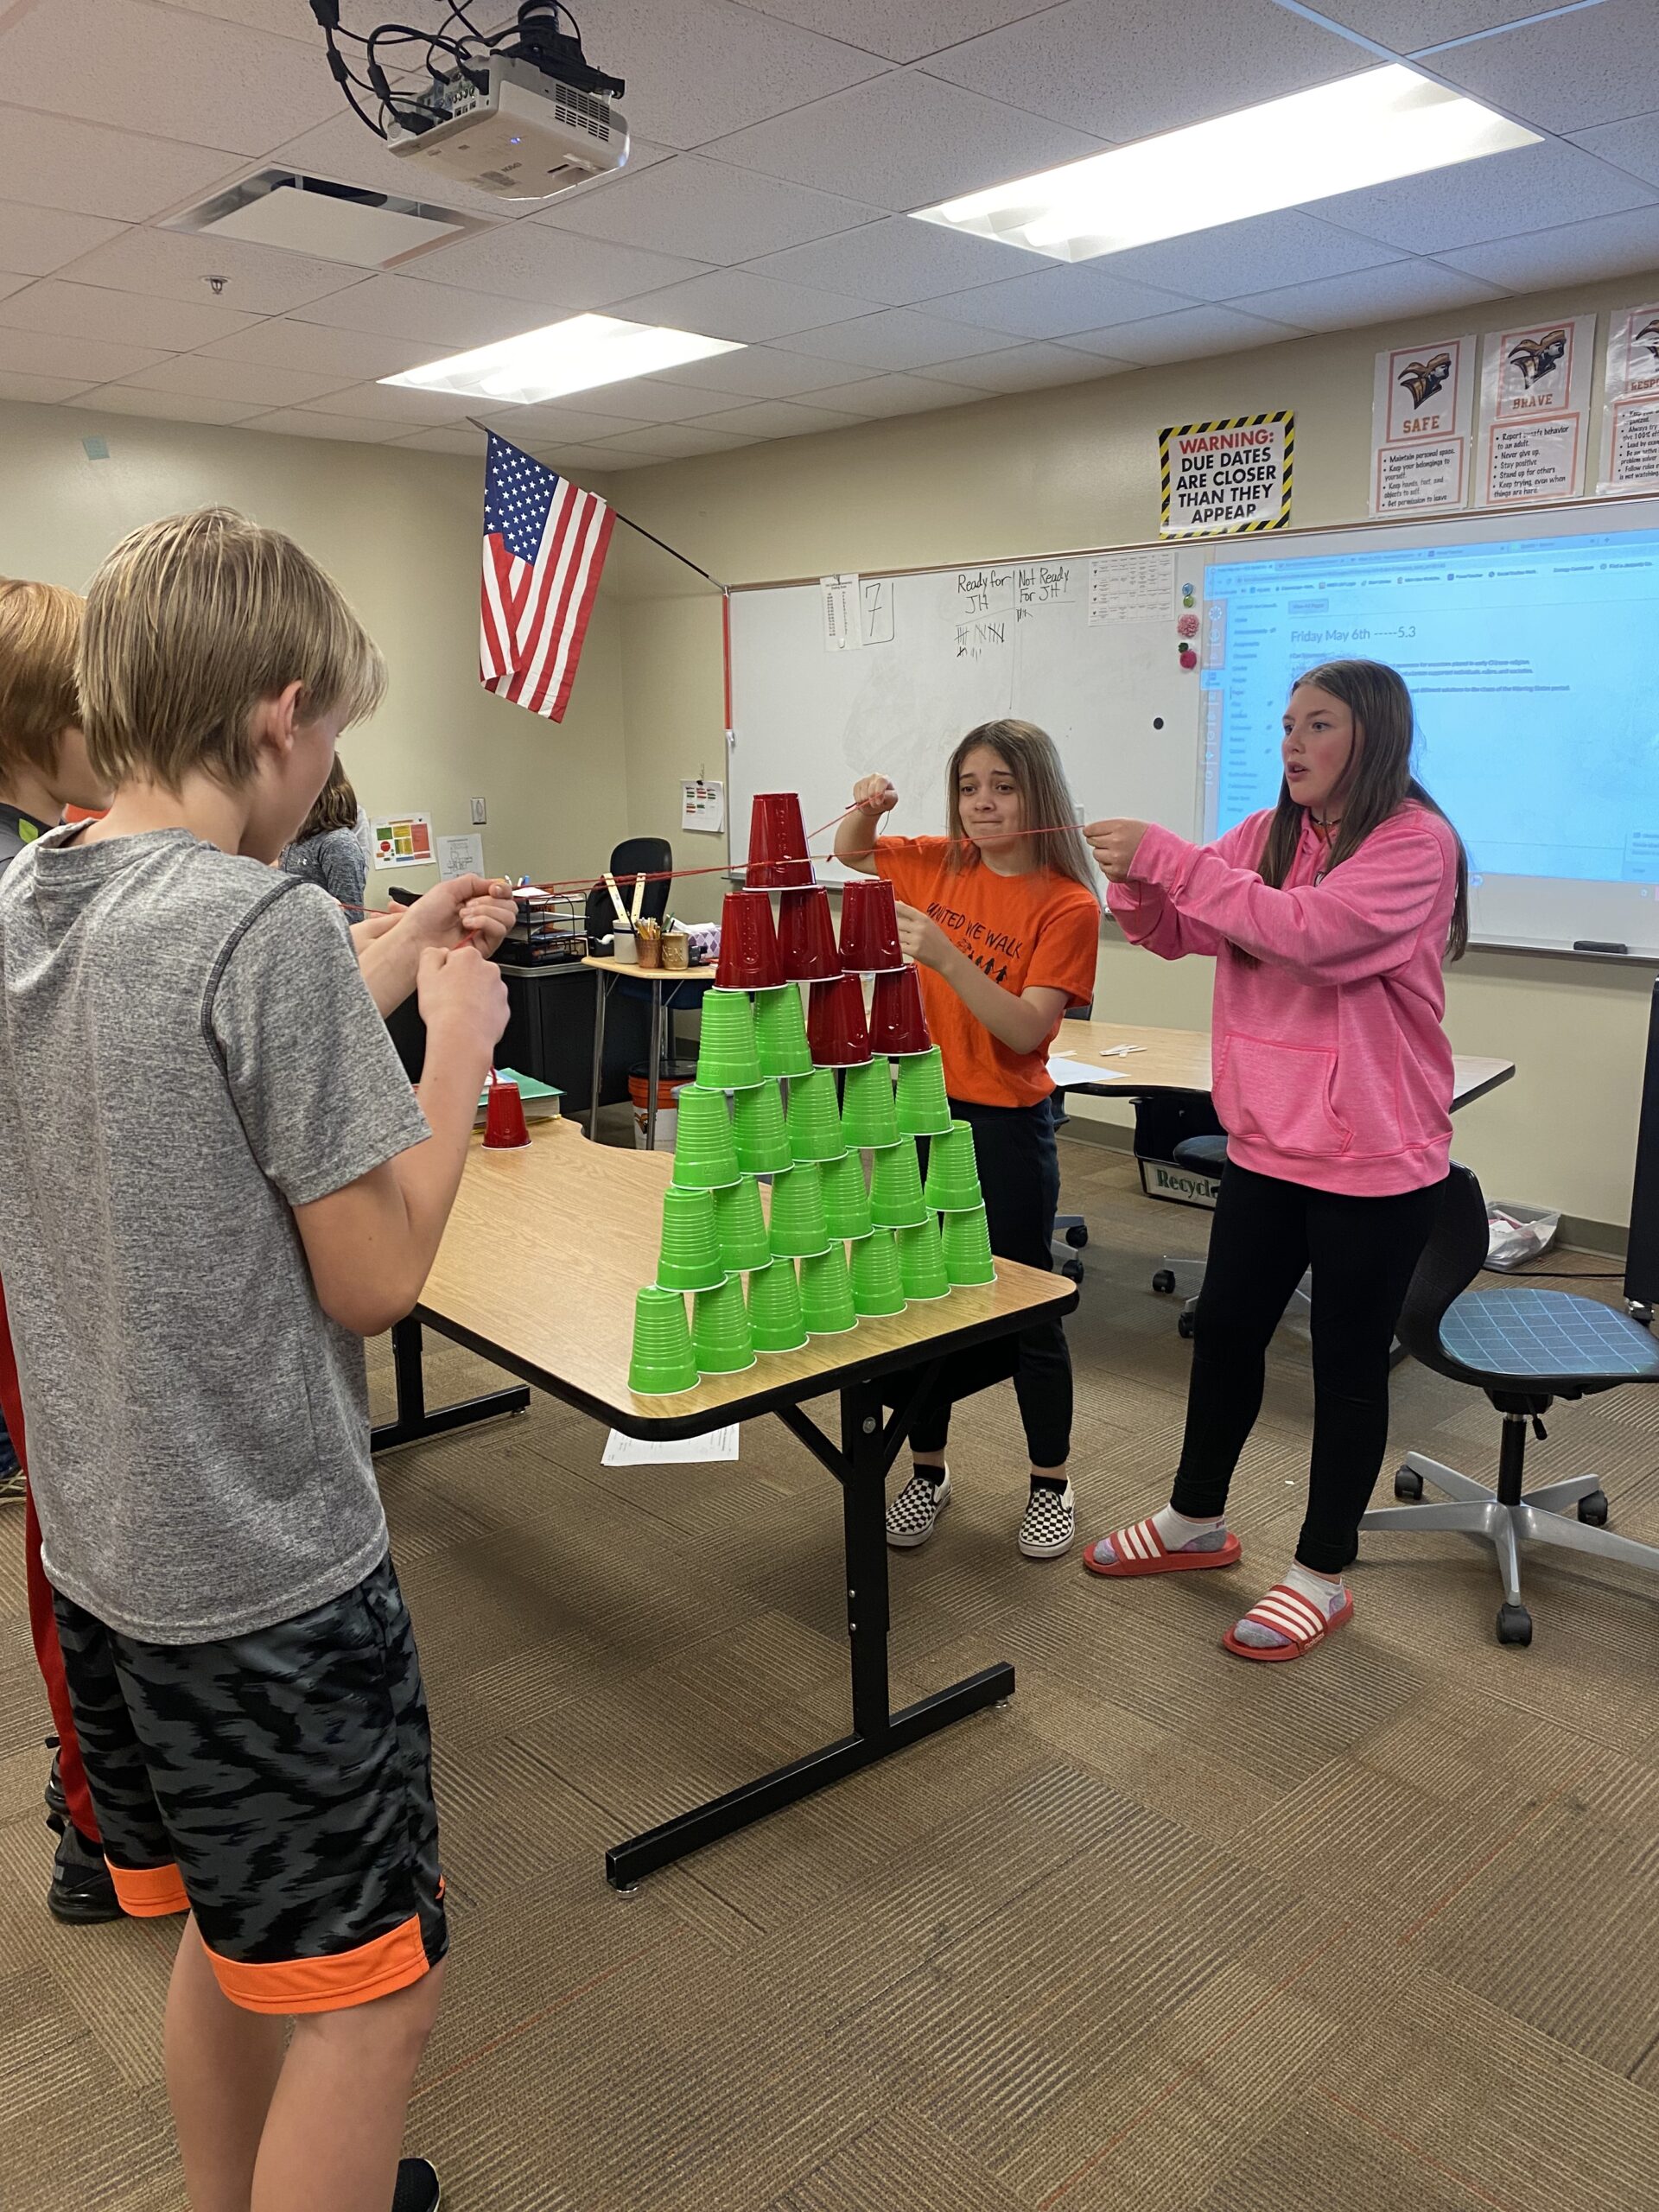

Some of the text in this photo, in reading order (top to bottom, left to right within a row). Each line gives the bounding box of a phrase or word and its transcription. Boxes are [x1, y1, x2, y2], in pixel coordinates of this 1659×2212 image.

[1512, 393, 1553, 410] BRAVE
[1403, 415, 1440, 433] SAFE
[1503, 432, 1522, 441] Report
[1544, 426, 1569, 435] behavior
[1629, 425, 1648, 434] Always
[1179, 429, 1274, 454] WARNING:
[1181, 447, 1271, 473] DUE DATES
[1389, 448, 1455, 463] Maintain personal space.
[1519, 449, 1530, 458] give
[1620, 457, 1641, 466] problem
[1402, 464, 1414, 473] your
[1415, 460, 1442, 469] belongings
[1516, 459, 1537, 468] positive
[1176, 465, 1276, 491] ARE CLOSER
[1179, 483, 1274, 508] THAN THEY
[1398, 498, 1426, 506] permission
[1191, 503, 1256, 524] APPEAR
[958, 569, 1012, 594] Ready for
[1019, 566, 1070, 593] Not Ready
[1020, 583, 1060, 603] For JH
[866, 582, 882, 637] 7
[965, 594, 988, 614] JH
[1291, 631, 1323, 644] Friday
[1325, 629, 1349, 643] May
[1351, 628, 1370, 640] 6th
[926, 902, 1023, 960] UNITED WE WALK
